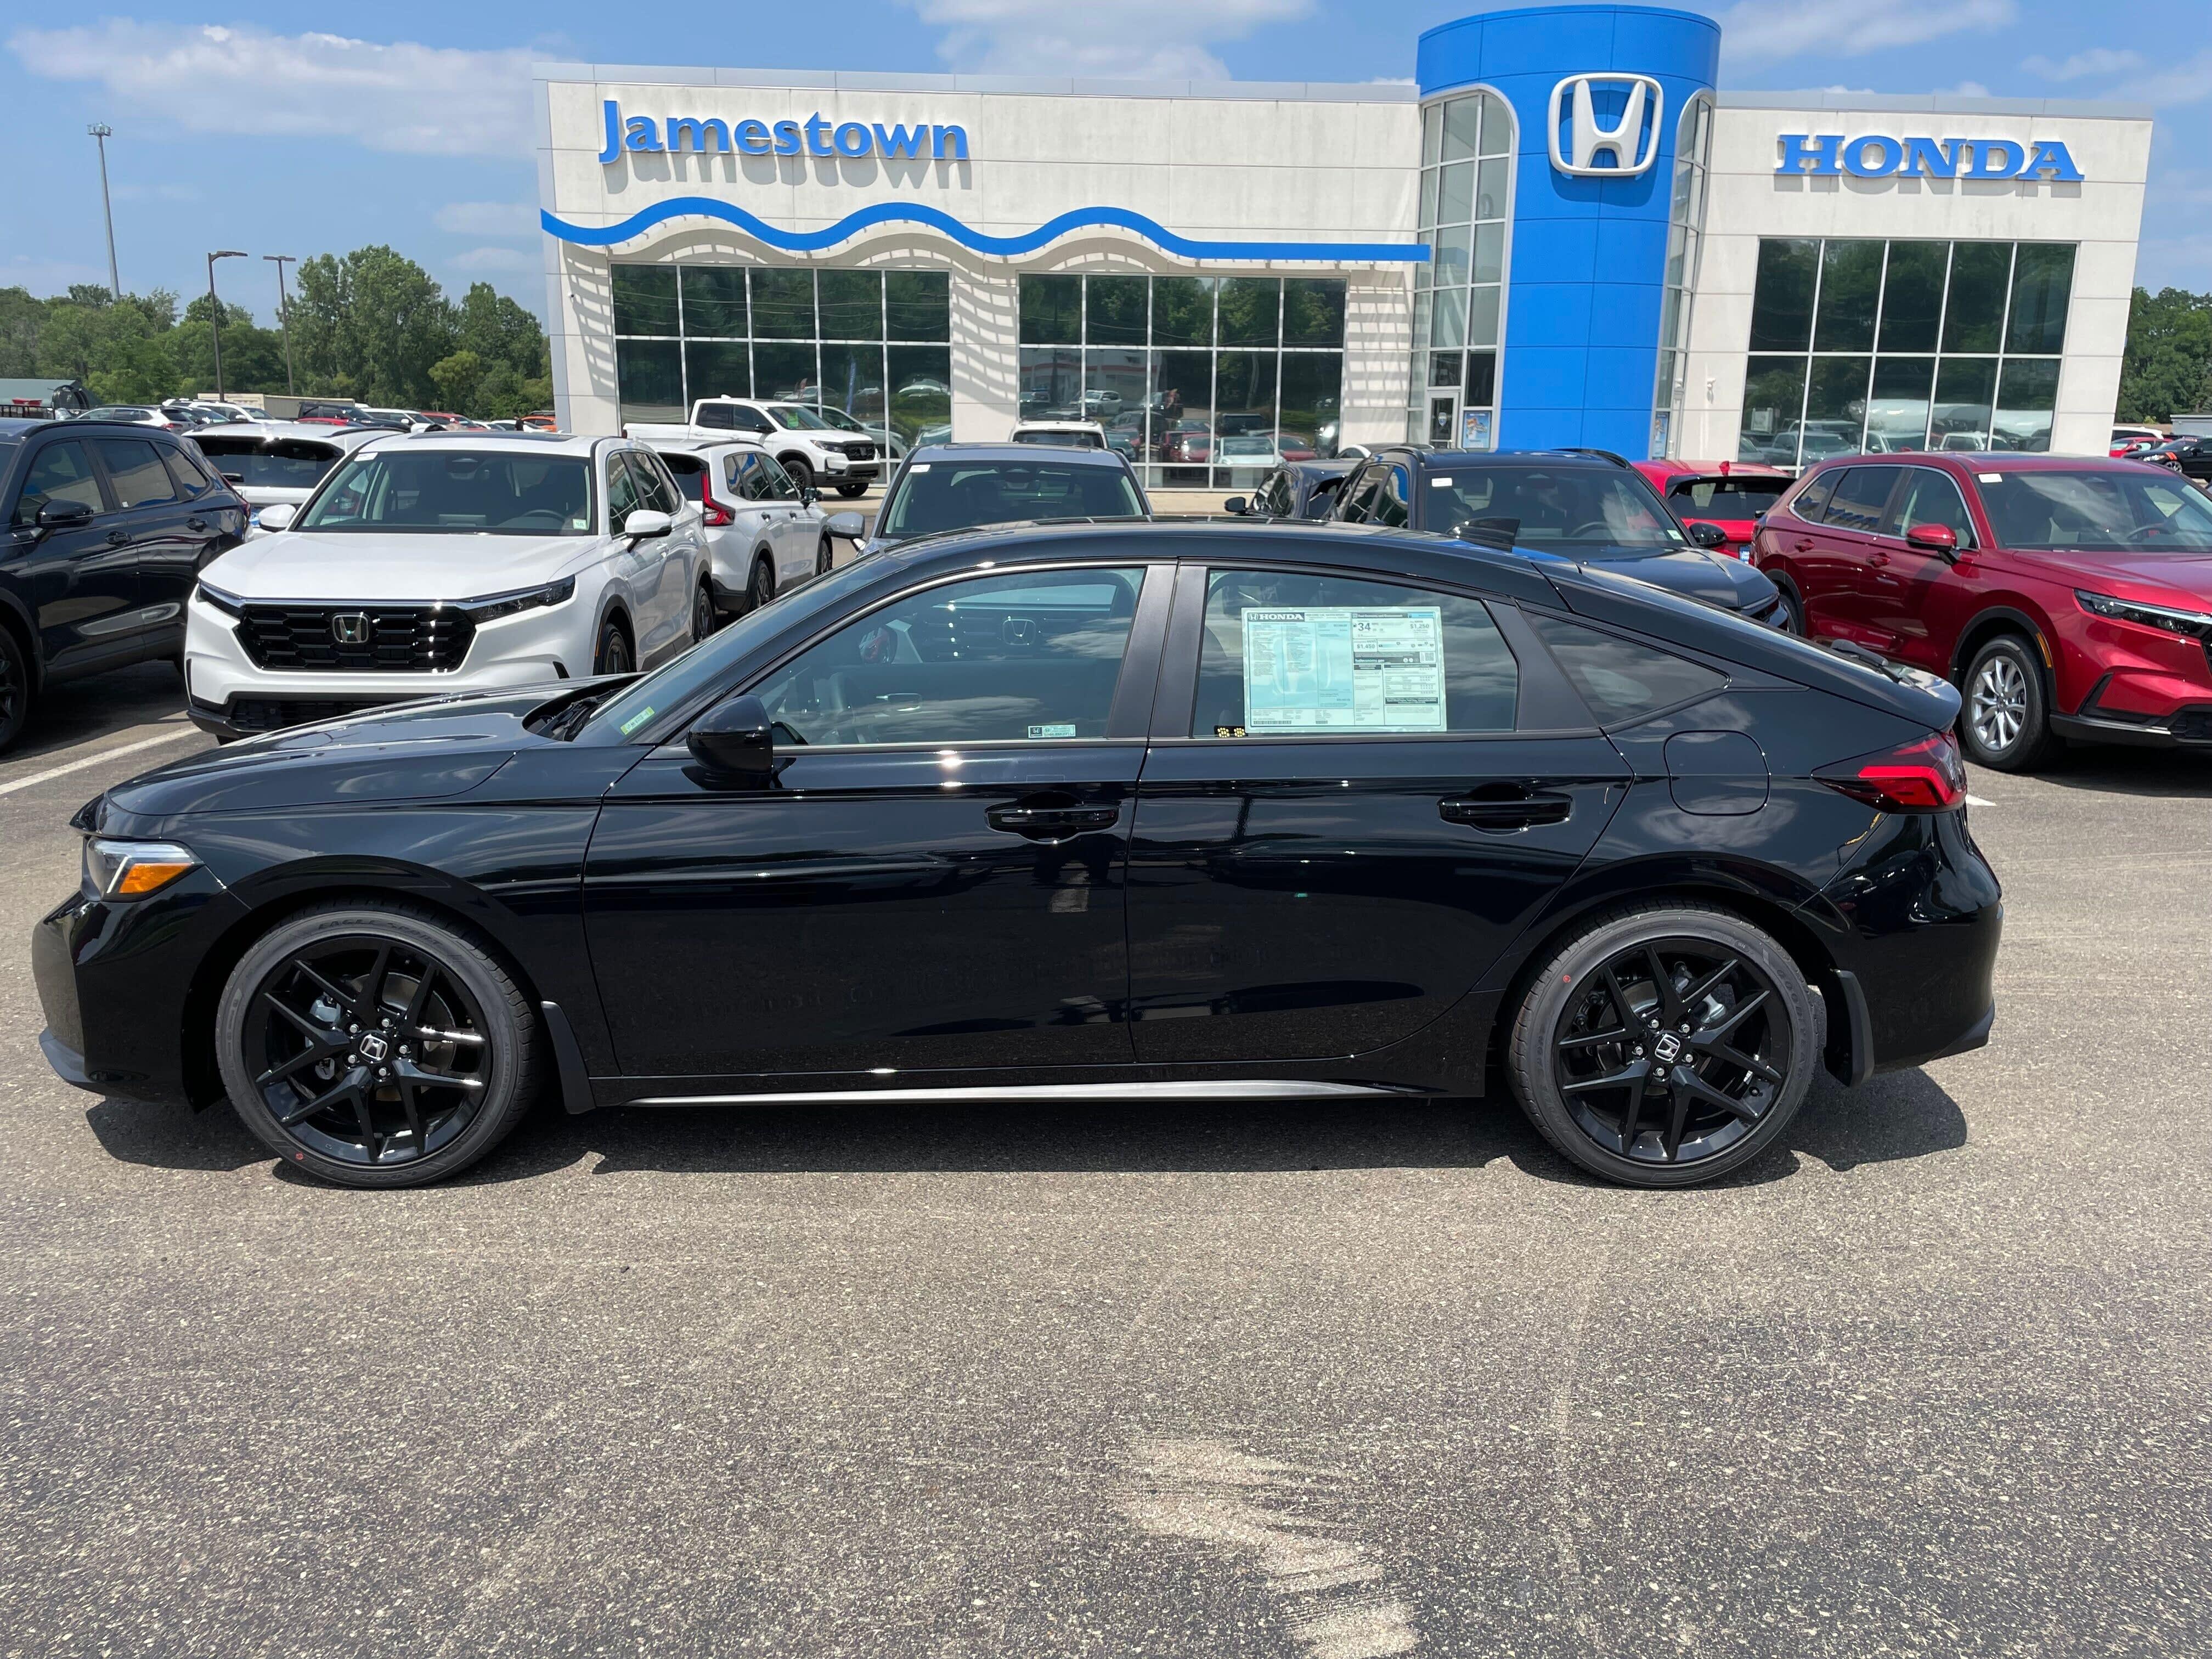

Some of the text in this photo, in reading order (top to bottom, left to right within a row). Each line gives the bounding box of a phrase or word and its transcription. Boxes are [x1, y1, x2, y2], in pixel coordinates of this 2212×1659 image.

[599, 100, 968, 163] Jamestown
[1774, 134, 2085, 182] HONDA
[1358, 623, 1371, 631] 34
